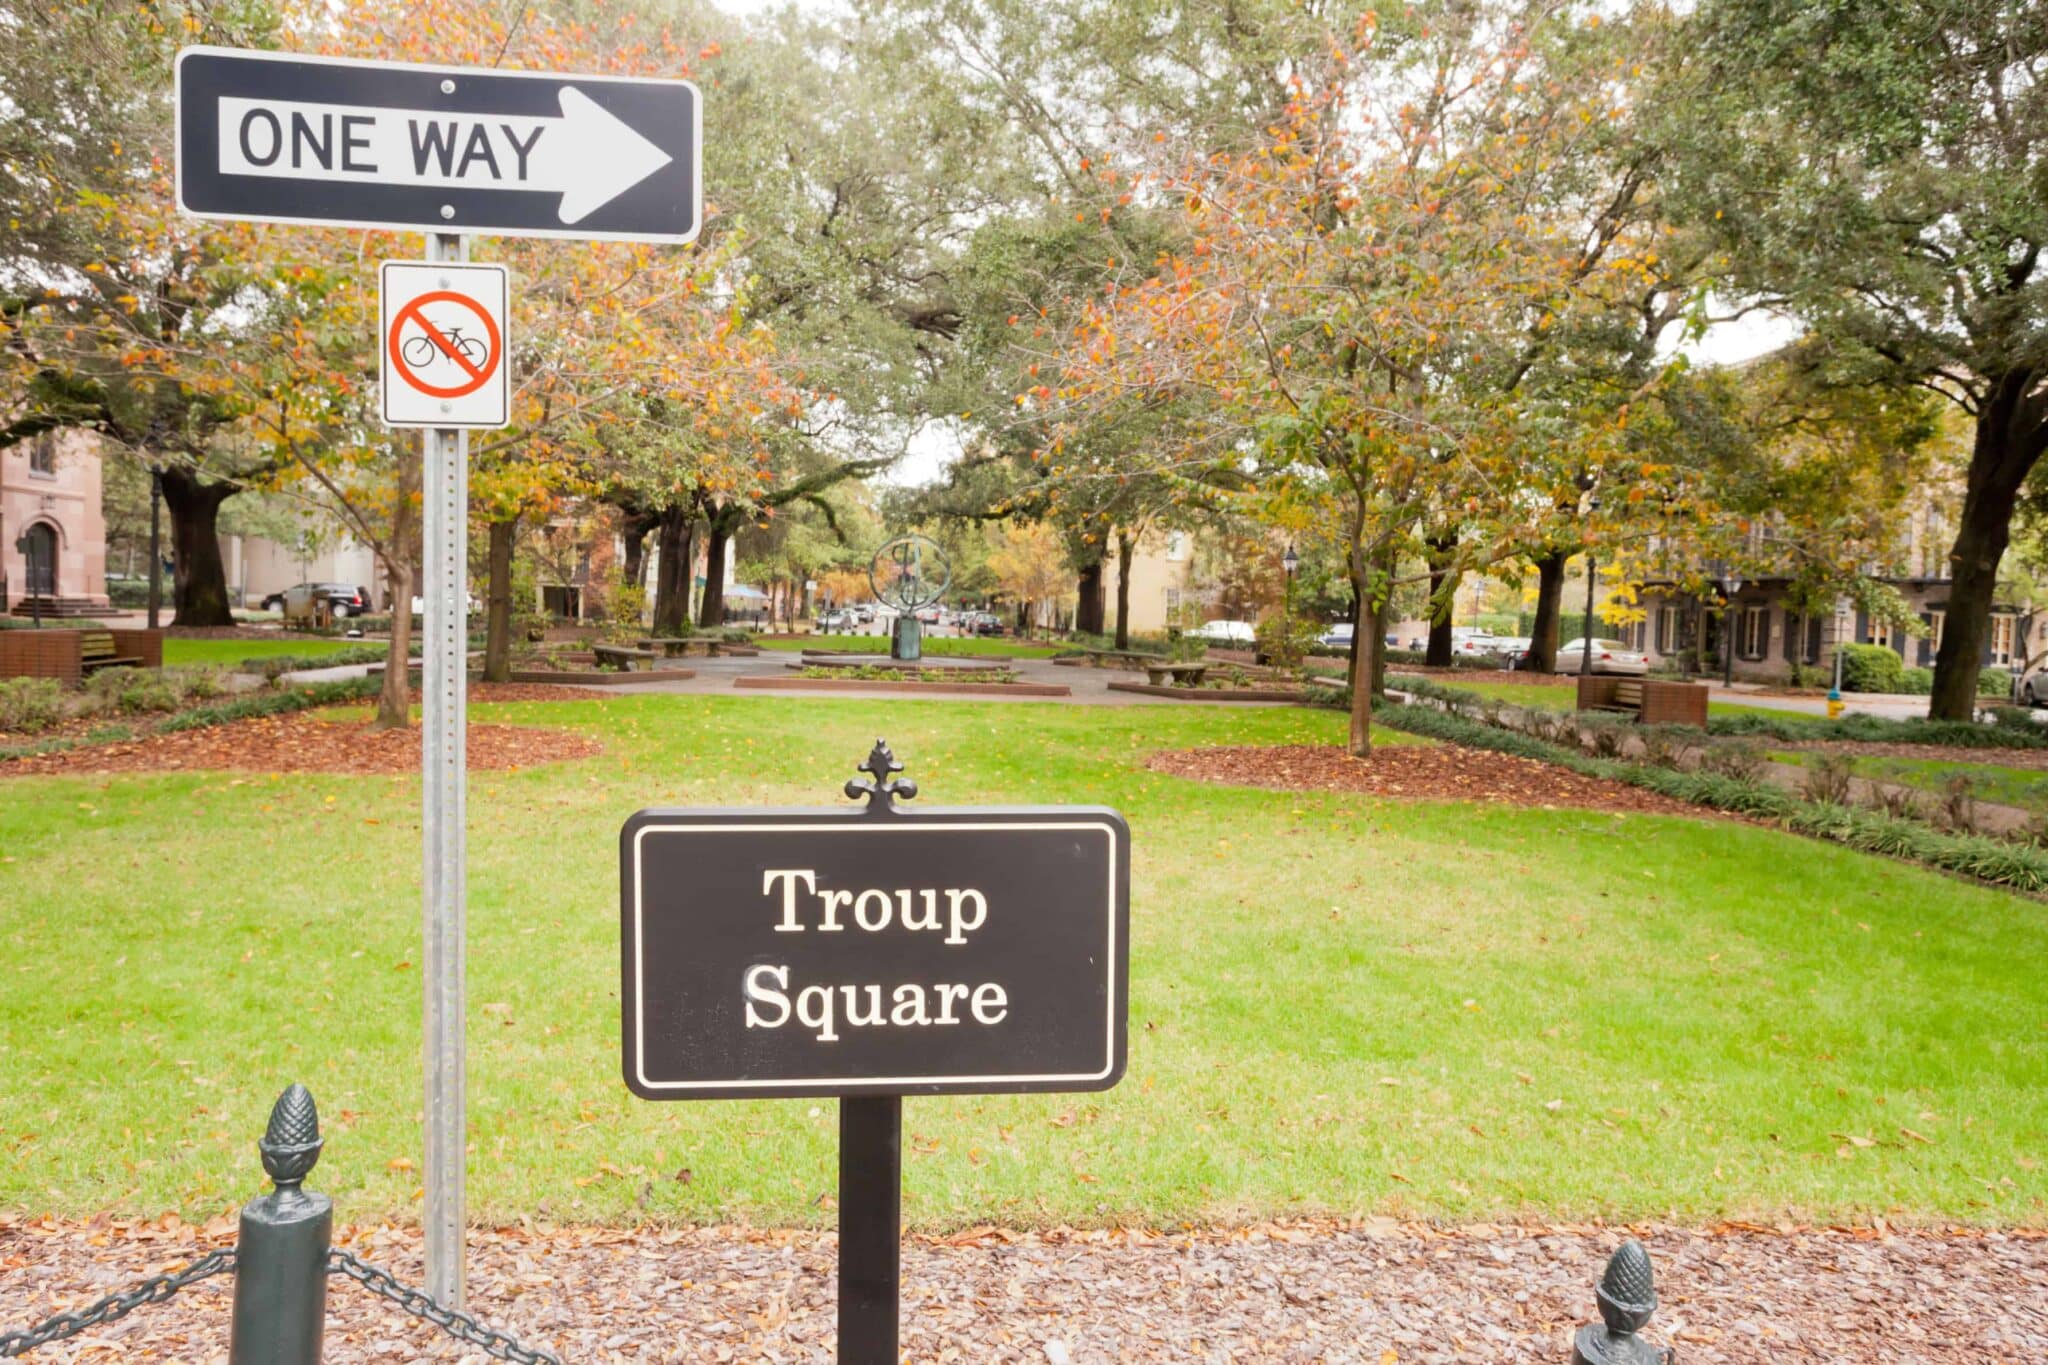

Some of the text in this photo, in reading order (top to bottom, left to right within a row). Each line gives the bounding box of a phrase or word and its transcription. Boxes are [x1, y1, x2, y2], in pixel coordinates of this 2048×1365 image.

[239, 108, 545, 181] ONE WAY
[763, 869, 988, 945] Troup
[745, 965, 1008, 1042] Square
